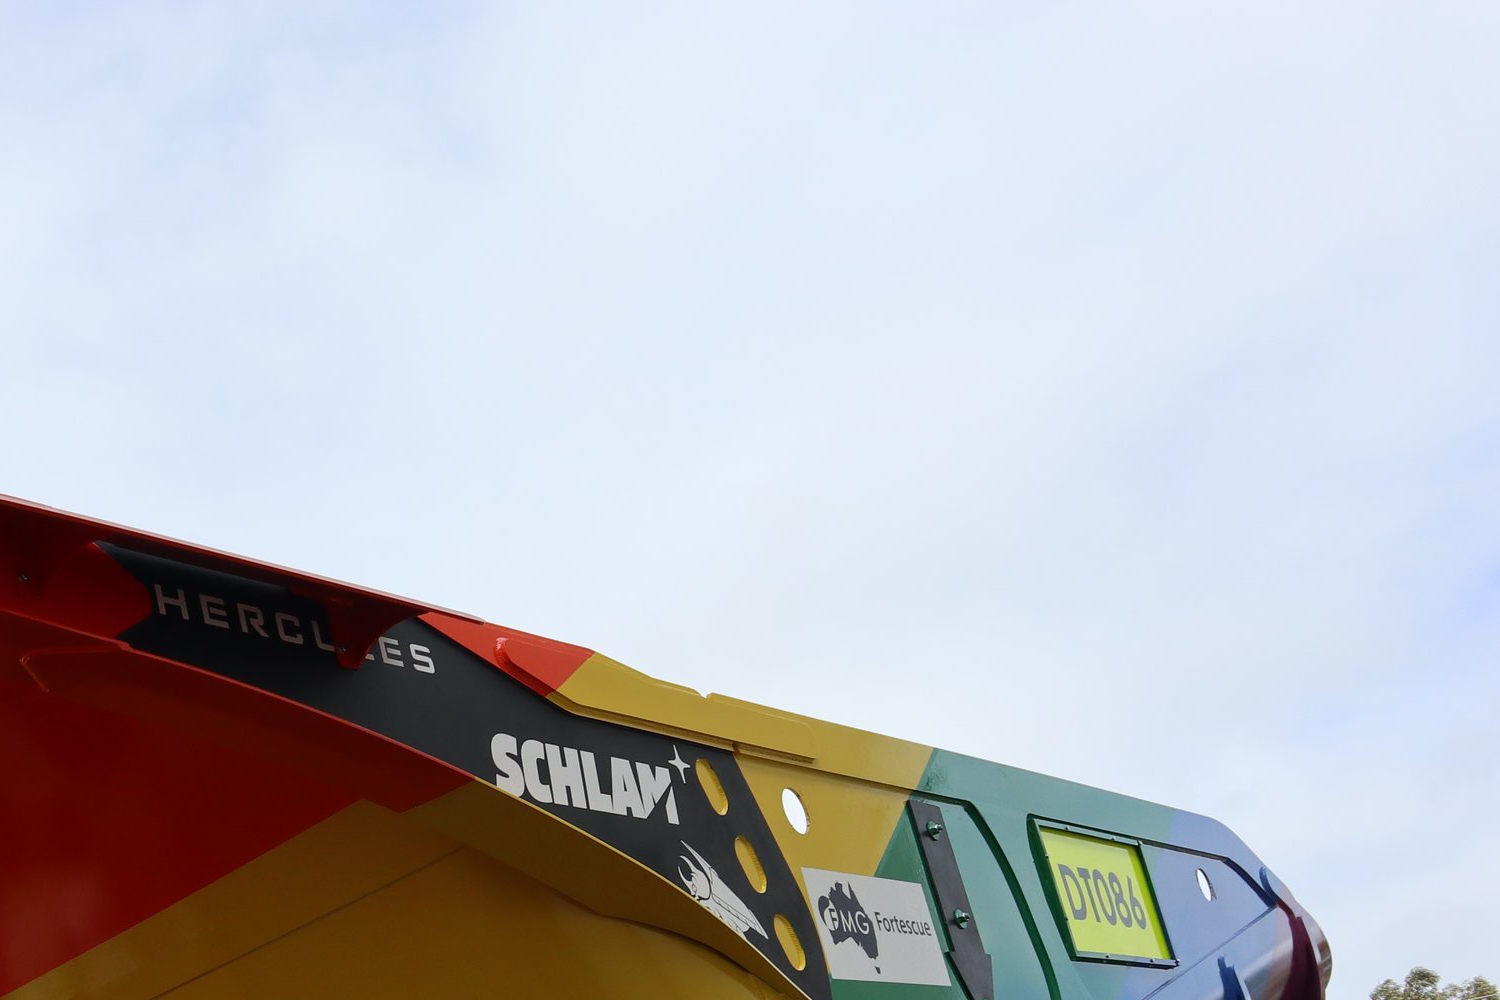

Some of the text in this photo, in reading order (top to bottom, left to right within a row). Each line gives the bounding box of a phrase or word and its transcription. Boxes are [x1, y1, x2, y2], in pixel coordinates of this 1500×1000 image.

[490, 732, 680, 825] SCHLAM
[1057, 863, 1147, 930] DT086
[828, 907, 871, 935] FMG
[874, 911, 933, 937] Fortescue
